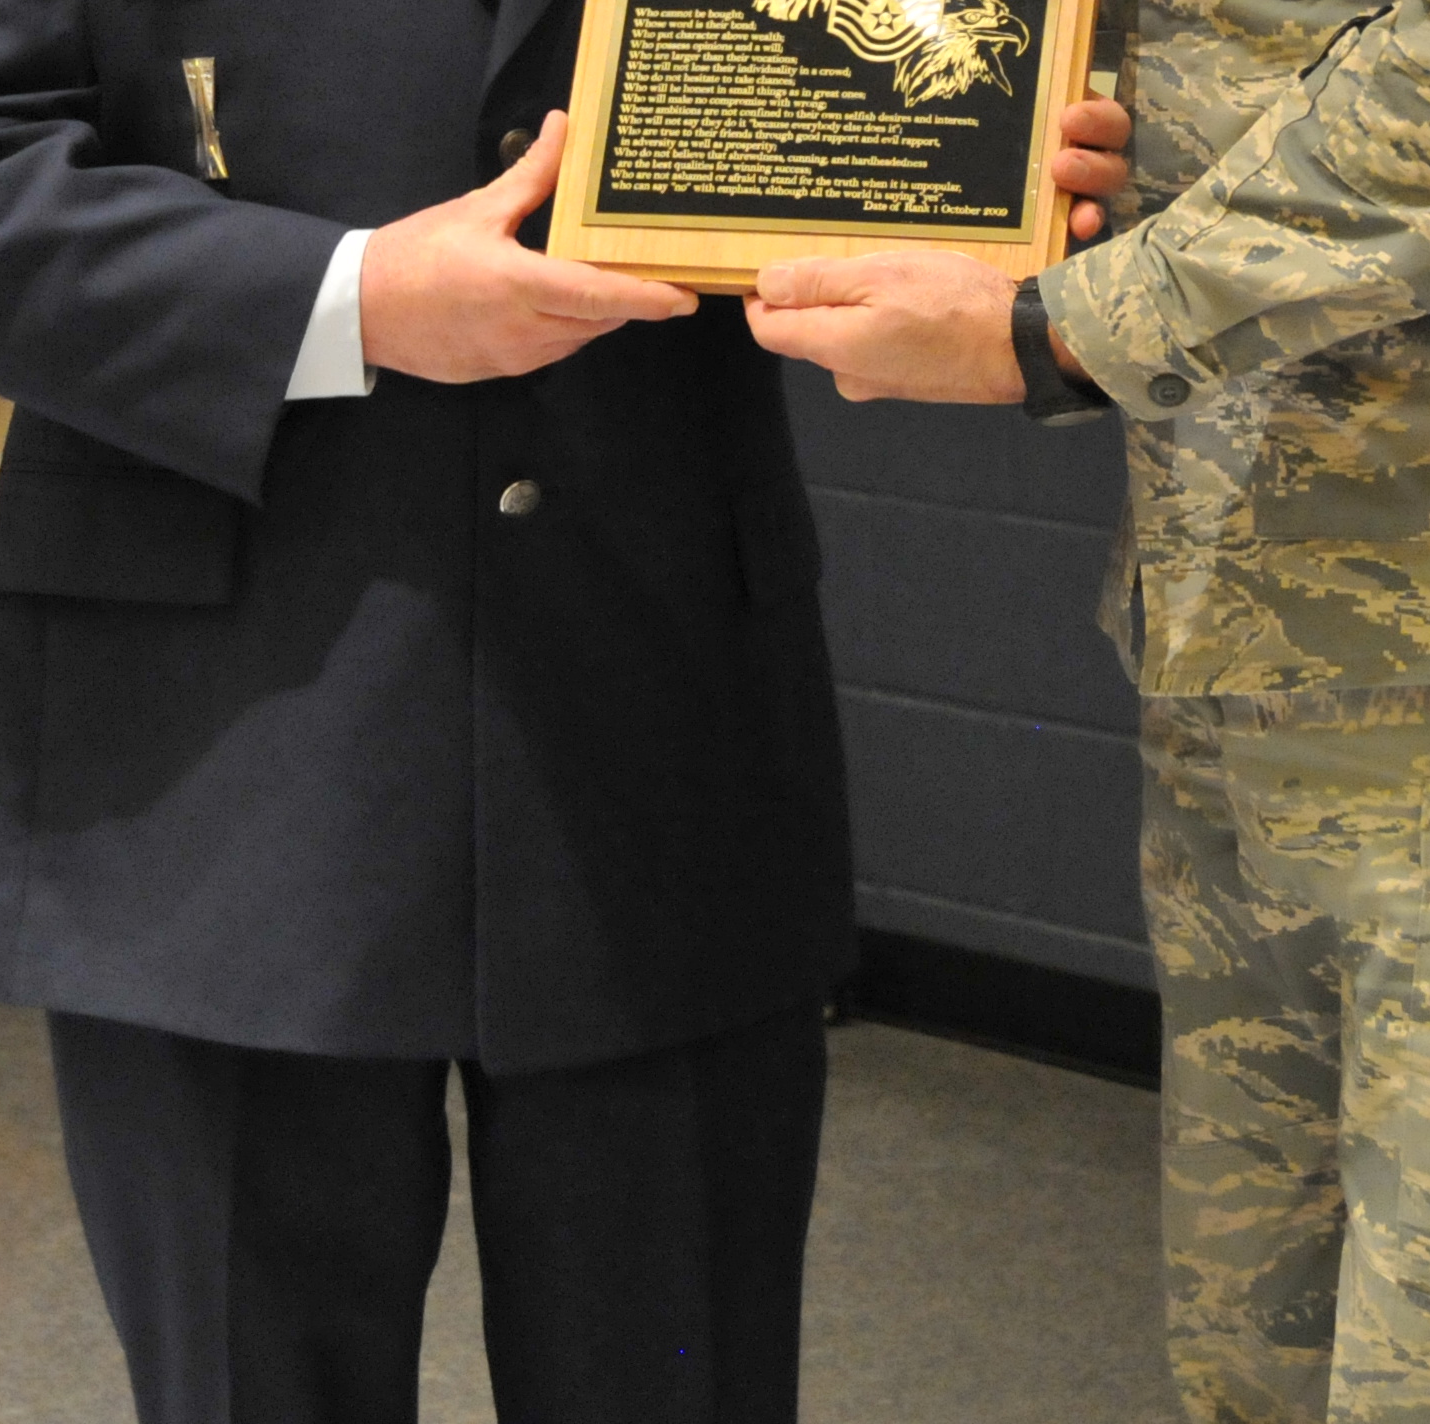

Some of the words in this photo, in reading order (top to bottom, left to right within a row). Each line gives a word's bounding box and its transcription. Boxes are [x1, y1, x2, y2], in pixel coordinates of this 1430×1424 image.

[635, 7, 660, 17] Who
[660, 9, 693, 18] cannot
[633, 18, 667, 27] Whose
[668, 19, 694, 28] word
[705, 20, 729, 30] their
[631, 29, 656, 38] Who
[657, 30, 674, 41] put
[675, 30, 720, 40] character
[721, 32, 749, 41] above
[630, 39, 655, 49] Who
[692, 41, 734, 53] opinions
[734, 43, 753, 52] and
[628, 50, 653, 59] Who
[671, 51, 701, 63] larger
[702, 53, 724, 62] than
[726, 53, 750, 63] their
[626, 61, 652, 70] Who
[652, 62, 671, 71] will
[672, 63, 689, 71] not
[691, 63, 711, 72] lose
[712, 64, 736, 73] their
[737, 65, 798, 77] individuality
[625, 71, 650, 81] Who
[665, 73, 682, 82] not
[683, 73, 720, 83] hesitate
[734, 75, 755, 84] take
[623, 82, 648, 92] Who
[649, 83, 668, 92] will
[683, 84, 715, 94] honest
[728, 86, 755, 95] small
[756, 87, 787, 99] things
[813, 89, 840, 100] great
[621, 93, 647, 102] Who
[648, 94, 666, 103] will
[668, 95, 694, 104] make
[708, 96, 767, 109] compromise
[769, 98, 791, 107] with
[619, 104, 654, 113] Whose
[655, 105, 702, 115] ambitions
[721, 108, 738, 116] not
[739, 108, 782, 118] confined
[795, 110, 820, 119] their
[844, 112, 876, 121] selfish
[878, 113, 912, 122] desires
[914, 114, 933, 123] and
[618, 115, 643, 124] Who
[644, 115, 663, 125] will
[664, 117, 681, 125] not
[682, 119, 699, 128] say
[700, 117, 723, 129] they
[790, 121, 841, 133] everybody
[842, 122, 862, 132] else
[863, 123, 886, 133] does
[616, 125, 642, 135] Who
[660, 128, 681, 136] true
[694, 128, 718, 138] their
[719, 129, 753, 139] friends
[754, 130, 794, 142] through
[795, 132, 821, 143] good
[861, 134, 880, 143] and
[881, 135, 899, 144] evil
[632, 137, 676, 149] adversity
[690, 139, 711, 148] well
[613, 147, 638, 157] Who
[653, 149, 670, 158] not
[672, 149, 706, 159] believe
[707, 150, 727, 160] that
[831, 155, 850, 164] and
[851, 156, 928, 167] hardheadedness
[634, 159, 651, 168] the
[652, 159, 672, 169] best
[673, 160, 715, 172] qualities
[716, 162, 731, 171] for
[732, 162, 773, 175] winning
[610, 169, 635, 178] Who
[653, 171, 670, 180] not
[672, 171, 714, 181] ashamed
[728, 173, 756, 183] afraid
[770, 175, 797, 184] stand
[799, 176, 814, 185] for
[815, 176, 832, 185] the
[833, 177, 860, 186] truth
[861, 178, 888, 188] when
[611, 180, 632, 189] who
[633, 182, 651, 190] can
[652, 183, 668, 193] say
[693, 183, 716, 192] with
[764, 185, 809, 198] although
[810, 187, 823, 196] all
[825, 188, 842, 197] the
[843, 188, 872, 198] world
[884, 190, 917, 202] saying
